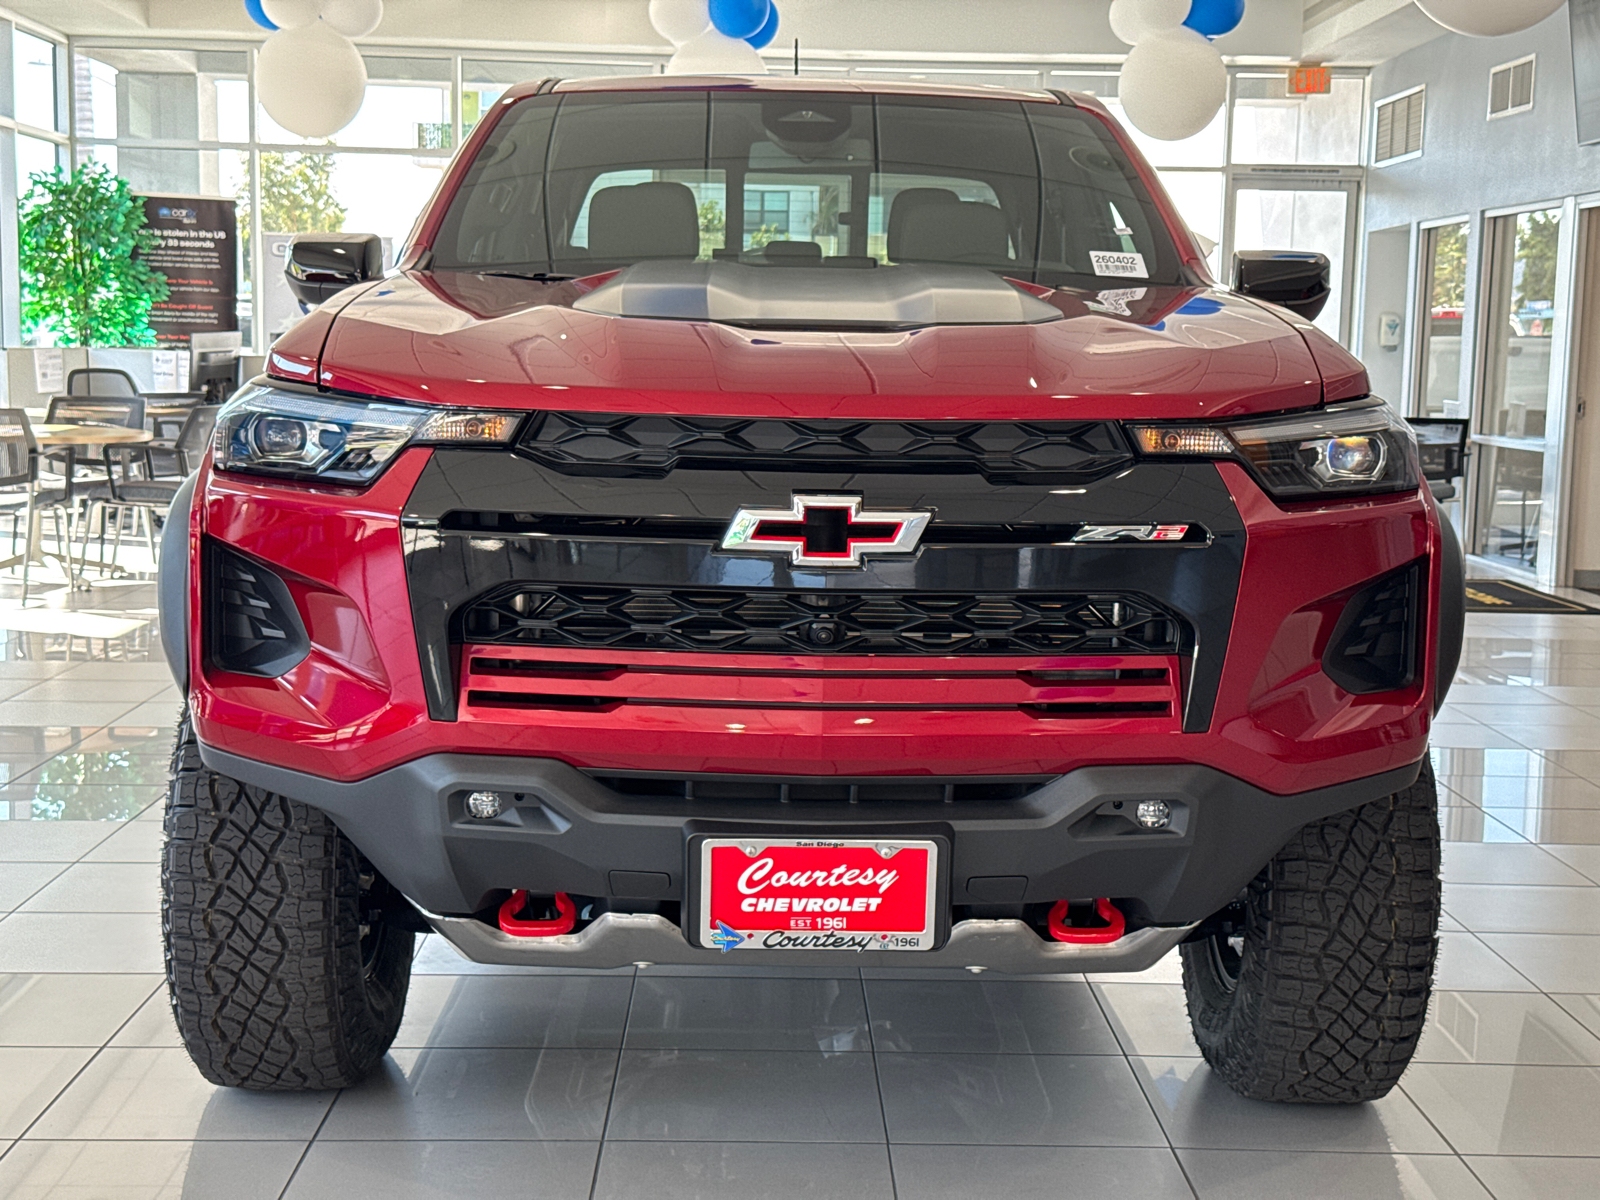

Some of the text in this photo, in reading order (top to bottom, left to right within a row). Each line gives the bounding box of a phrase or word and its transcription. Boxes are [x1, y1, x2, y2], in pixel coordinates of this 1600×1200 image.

[1295, 68, 1327, 93] EXIT
[163, 228, 189, 238] stolen
[198, 230, 213, 239] the
[179, 240, 216, 249] seconds
[1094, 255, 1137, 266] 260402
[1070, 525, 1189, 541] ZR2
[737, 858, 900, 895] Courtesy
[740, 897, 883, 912] CHEVROLET
[790, 917, 847, 929] EST 1961
[762, 930, 874, 953] Courtesy
[895, 937, 920, 947] 1961
